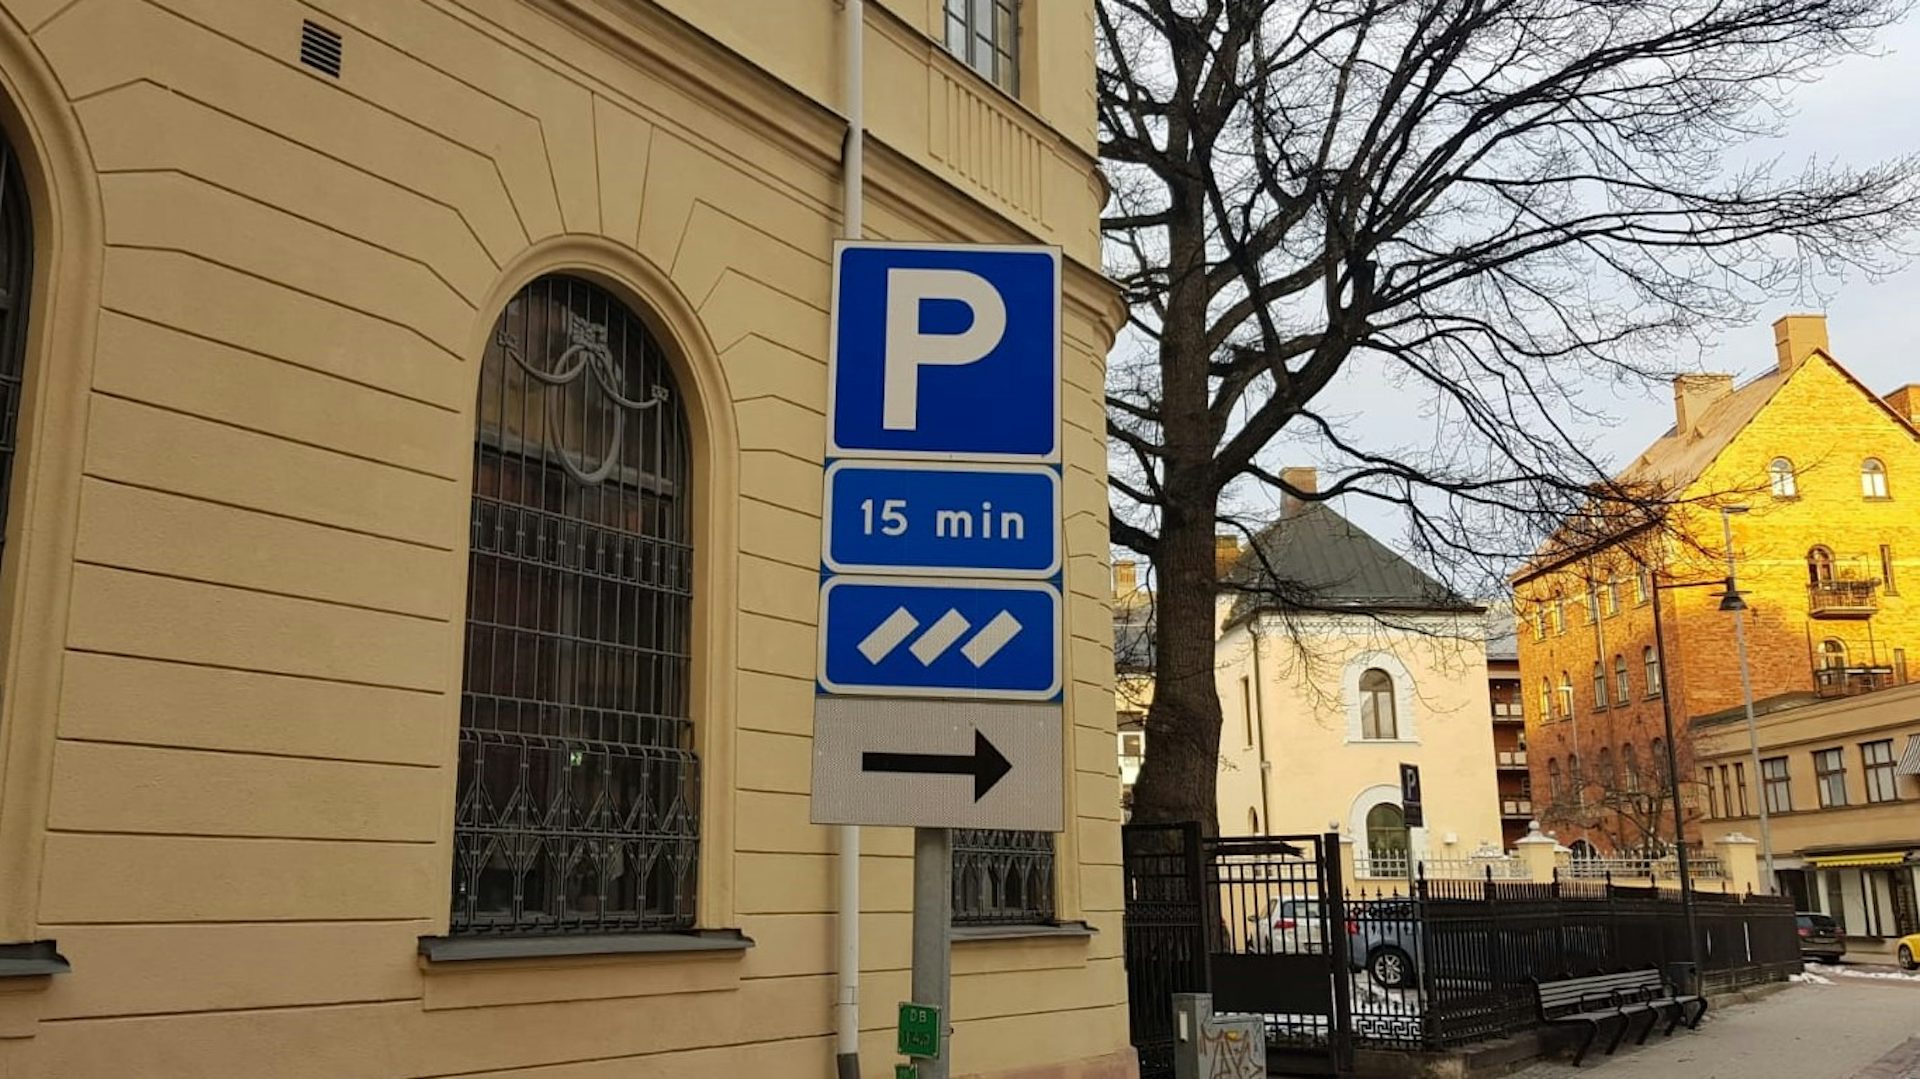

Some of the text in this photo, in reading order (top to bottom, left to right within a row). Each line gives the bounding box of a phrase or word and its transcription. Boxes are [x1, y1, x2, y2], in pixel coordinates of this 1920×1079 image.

[882, 268, 1006, 430] P
[861, 499, 1025, 539] 15 min
[1406, 768, 1416, 799] P
